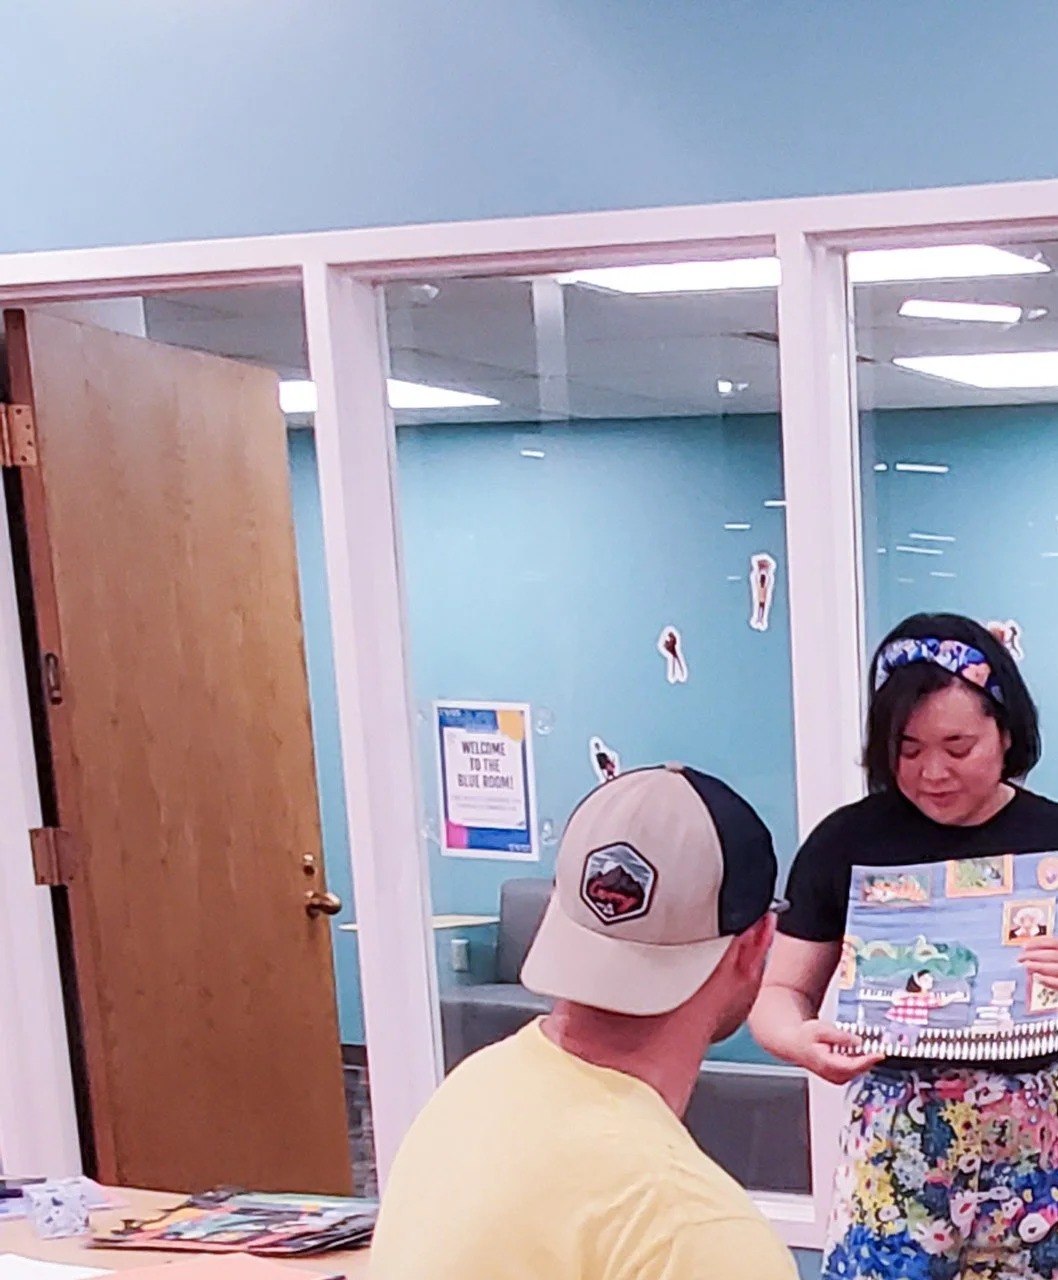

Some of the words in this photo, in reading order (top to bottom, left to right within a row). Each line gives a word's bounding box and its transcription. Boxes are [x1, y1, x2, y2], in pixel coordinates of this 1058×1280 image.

[462, 741, 506, 756] WELCOME
[470, 757, 482, 771] TO
[483, 758, 501, 773] THE
[457, 773, 480, 788] BLUE
[482, 775, 514, 790] ROOM!
